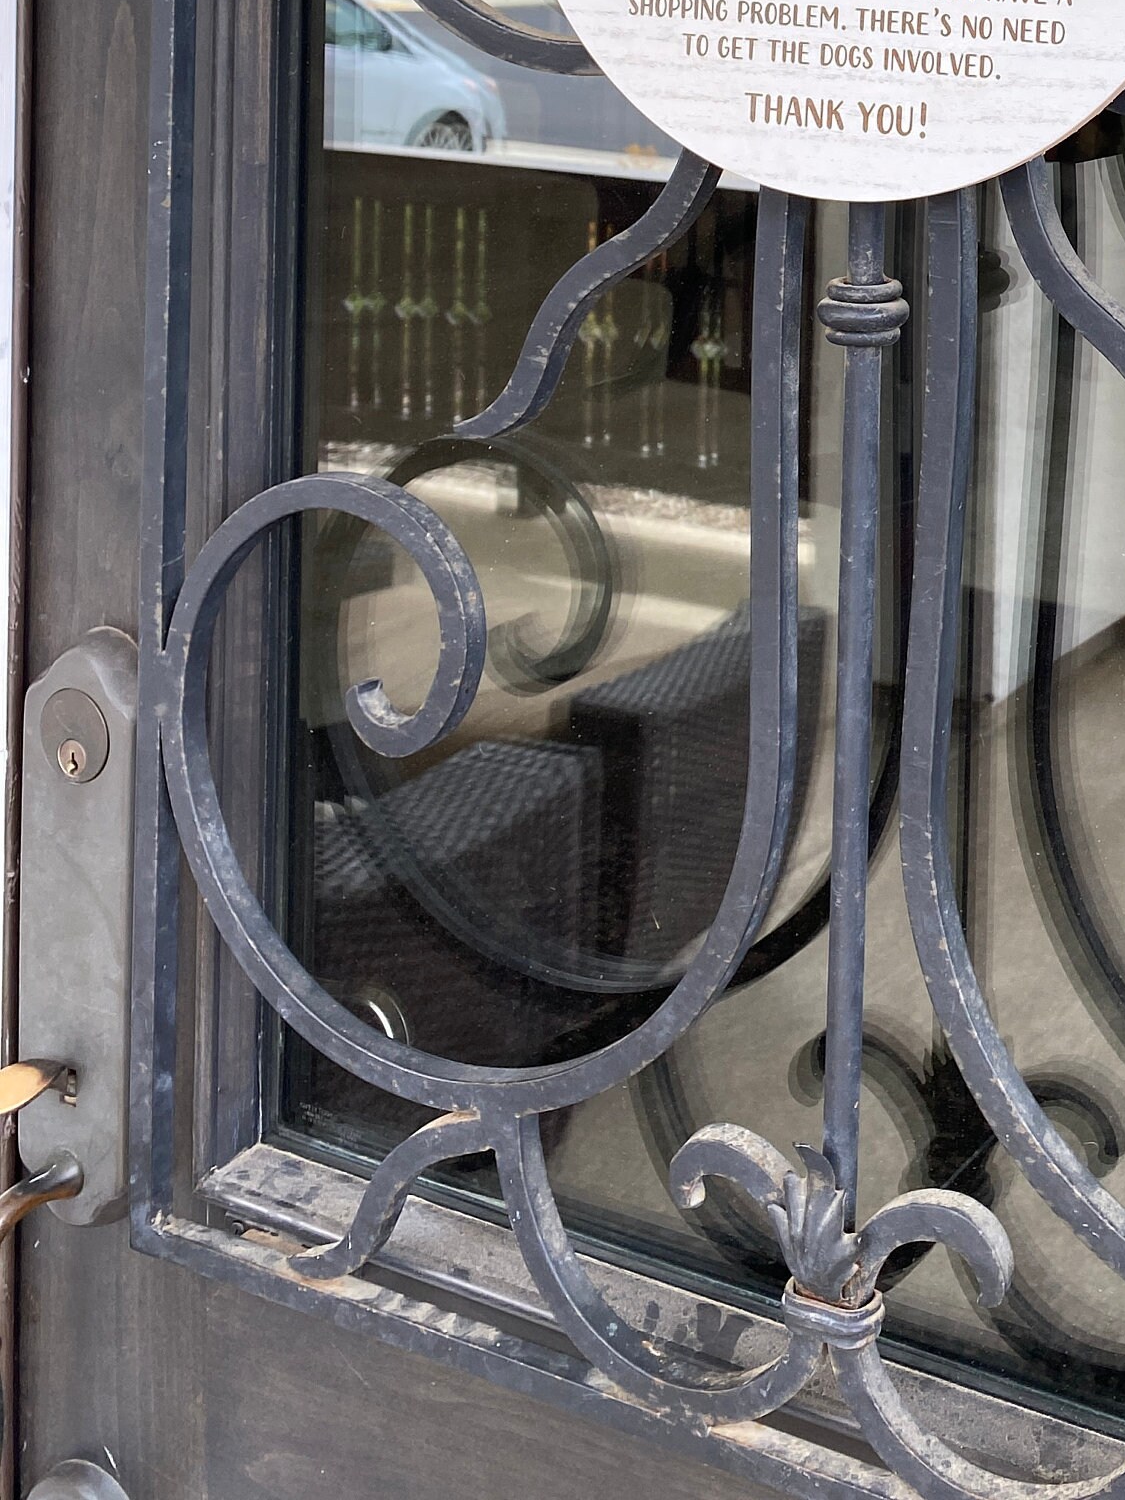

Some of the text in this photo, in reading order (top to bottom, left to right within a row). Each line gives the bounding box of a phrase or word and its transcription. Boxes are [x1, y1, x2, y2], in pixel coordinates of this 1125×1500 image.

[737, 0, 847, 31] PROBLEM.
[856, 7, 952, 38] THERE'S
[961, 14, 993, 41] NO
[1002, 16, 1066, 45] NEED
[683, 32, 1002, 80] TO GET THE DOGS INVOLVED.
[744, 91, 928, 139] THANK YOU!
